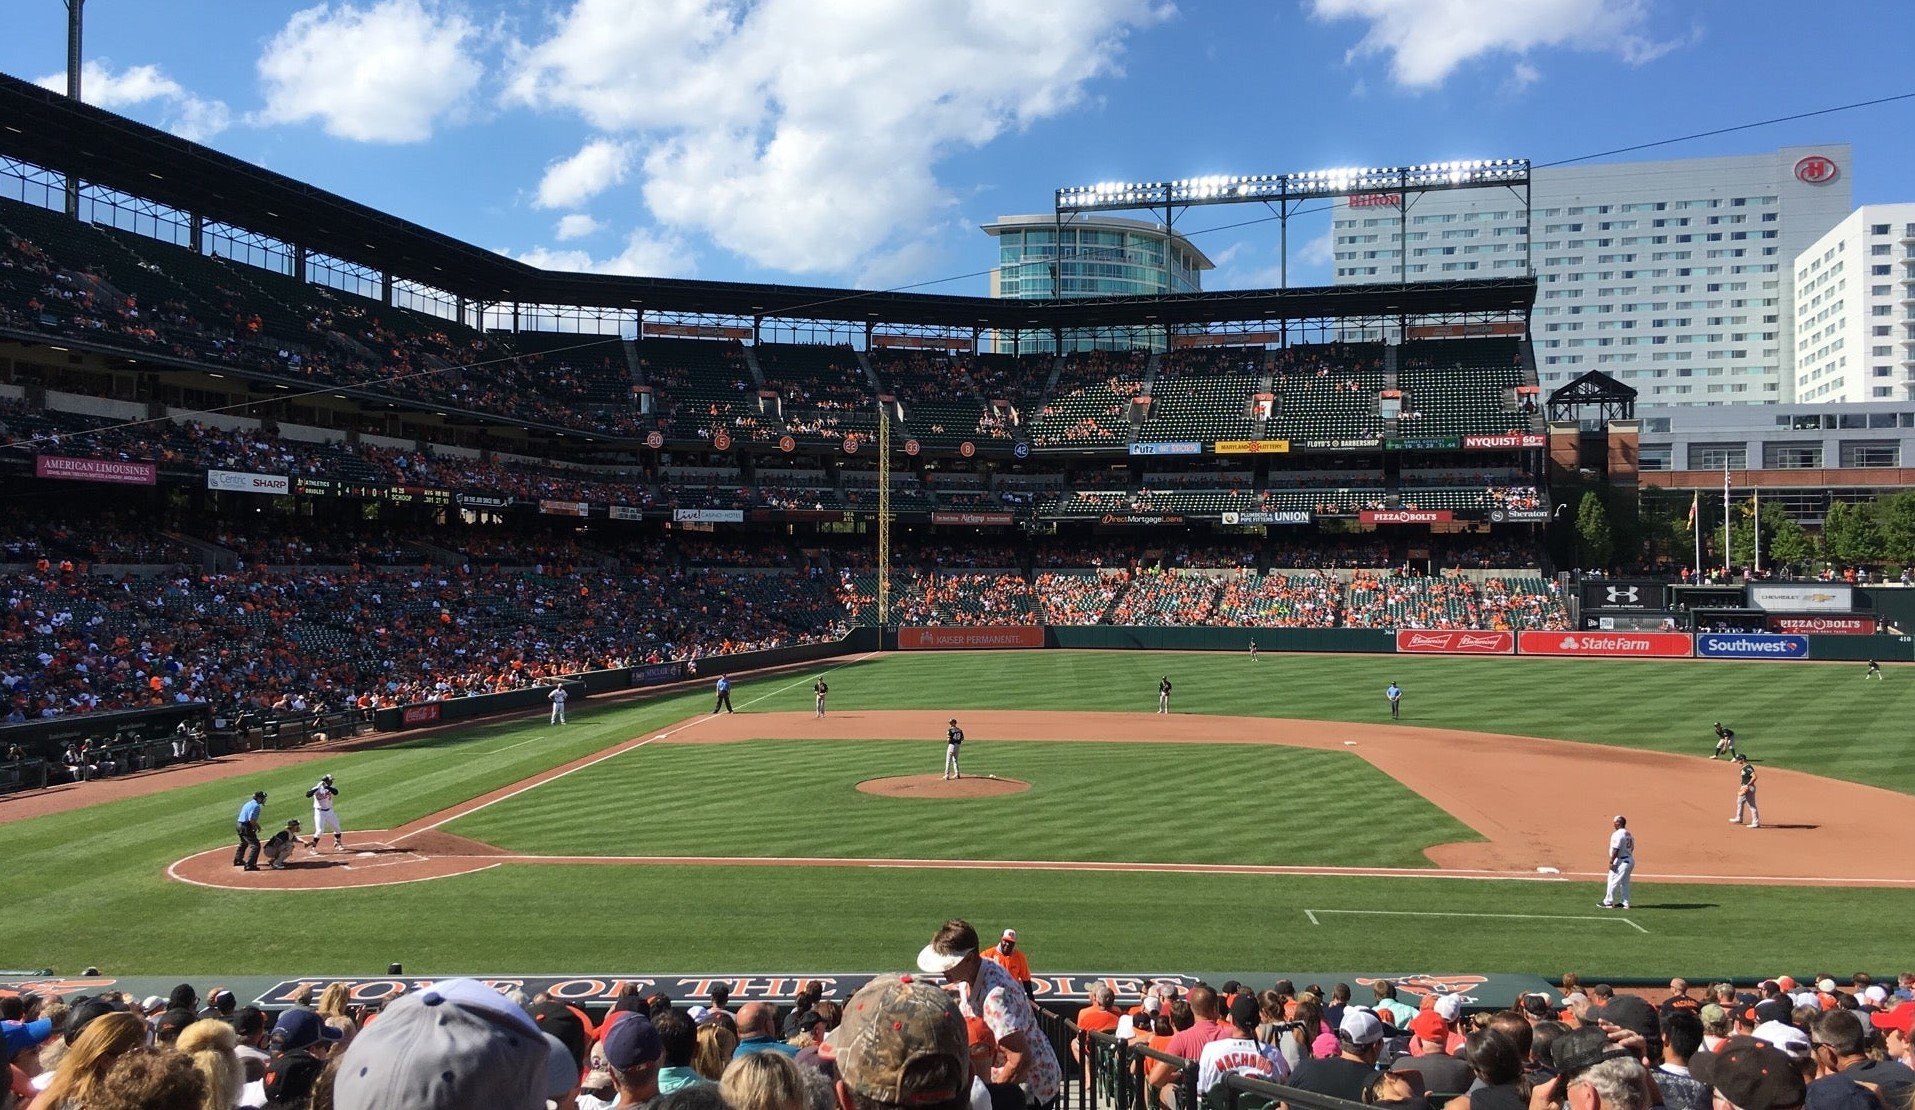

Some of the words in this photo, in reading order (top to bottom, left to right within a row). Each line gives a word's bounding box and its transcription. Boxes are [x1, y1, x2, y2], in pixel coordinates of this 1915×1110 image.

[1348, 194, 1400, 207] Hilton
[650, 436, 661, 444] 20
[719, 438, 725, 446] 5
[784, 440, 790, 448] 4
[1466, 437, 1516, 447] NYQUIST
[845, 442, 856, 450] 22
[908, 444, 917, 452] 33
[966, 445, 970, 453] 8
[1016, 446, 1027, 454] 42
[44, 460, 94, 472] AMERICAN
[96, 463, 150, 476] LIMOUSINES
[220, 474, 246, 484] Centric
[253, 479, 286, 488] SHARP
[361, 487, 365, 496] 1
[372, 488, 377, 496] 0
[384, 489, 388, 498] 1
[1275, 512, 1308, 521] UNION
[1780, 620, 1814, 628] PIZZA
[1826, 620, 1860, 628] BOLI'S
[937, 635, 964, 644] KAISER
[967, 635, 1020, 644] PERMANENTE
[1462, 637, 1497, 645] Budweiser
[1708, 638, 1786, 652] Southwest
[547, 979, 656, 998] OF
[676, 978, 837, 998] THE
[1215, 1053, 1273, 1075] MACHADO
